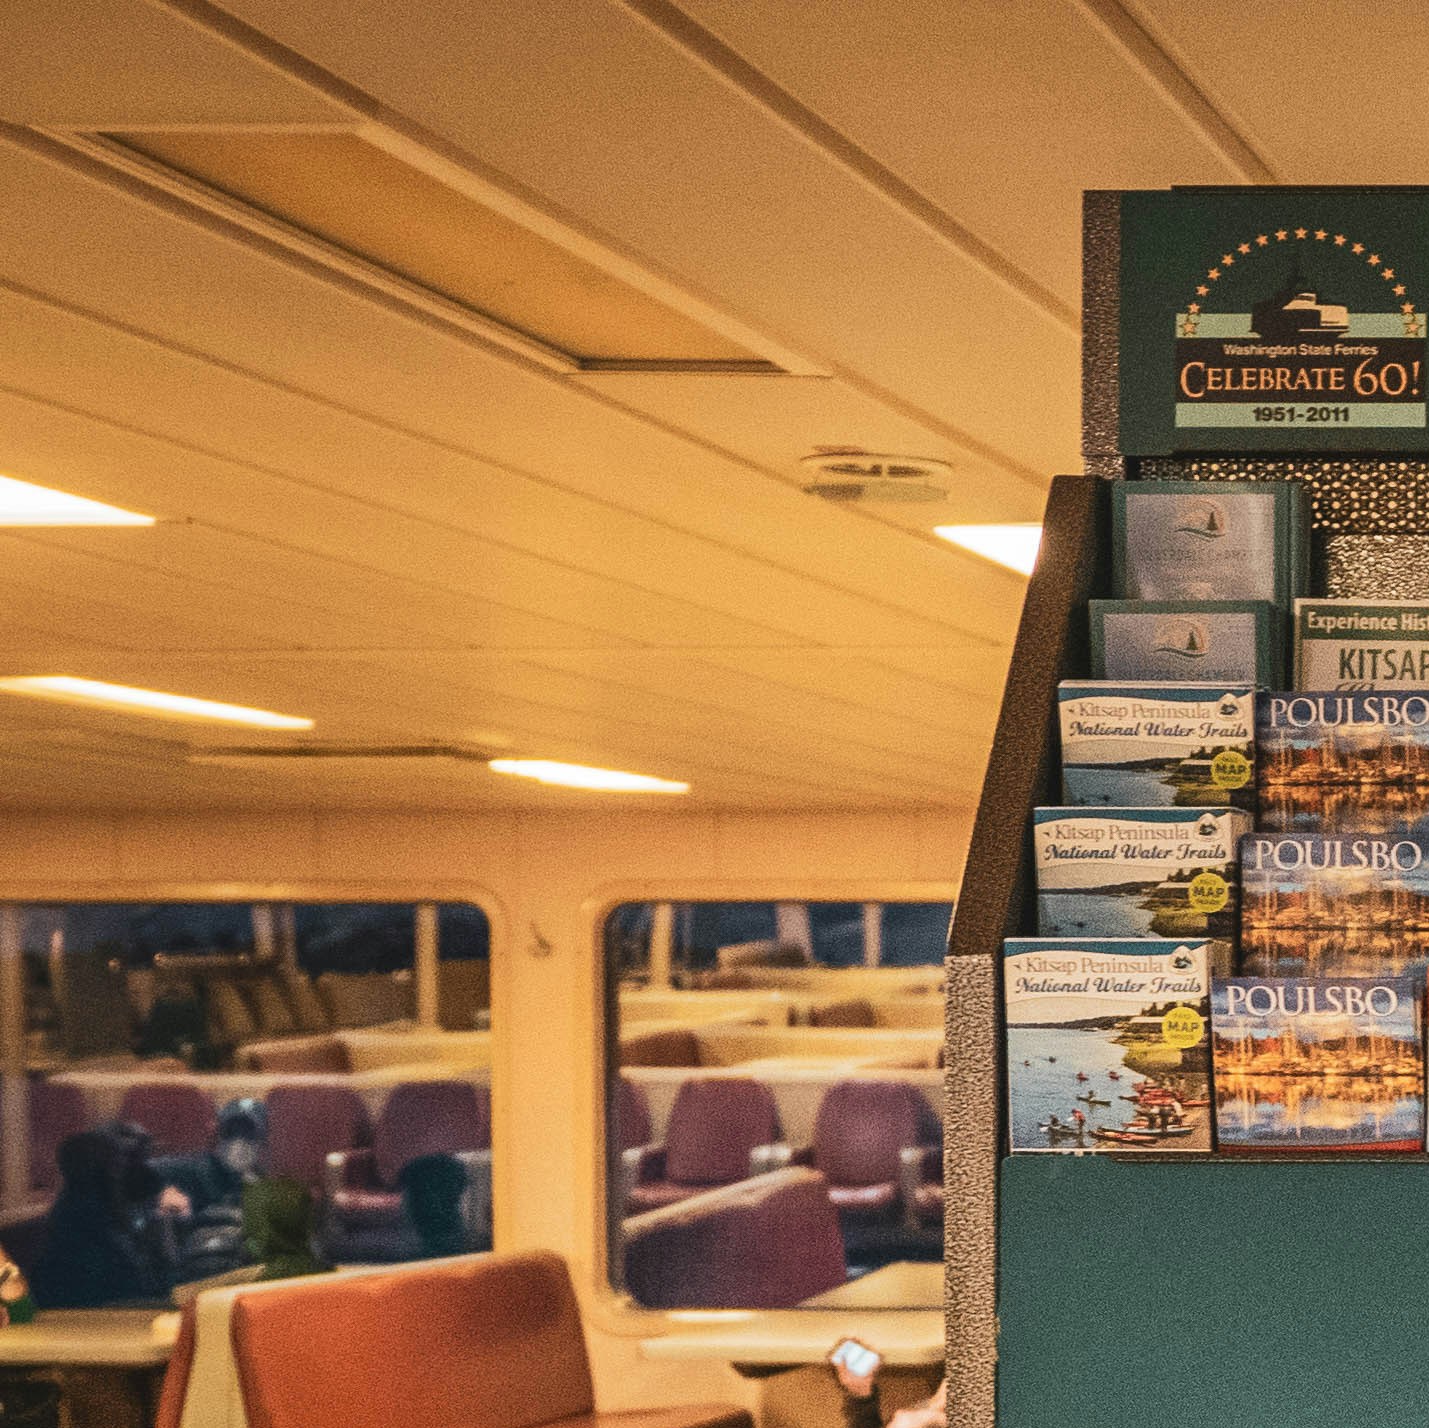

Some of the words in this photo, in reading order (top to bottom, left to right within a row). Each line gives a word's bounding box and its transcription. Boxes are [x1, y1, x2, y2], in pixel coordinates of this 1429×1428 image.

[1223, 344, 1297, 358] Washington
[1300, 344, 1331, 355] State
[1335, 344, 1378, 355] Ferries
[1353, 357, 1420, 395] 60!
[1253, 407, 1349, 422] 1951-2011
[1307, 612, 1397, 634] Experience
[1027, 957, 1078, 976] Kitsap
[1081, 957, 1164, 974] Peninsula
[1016, 977, 1091, 993] National
[1097, 977, 1146, 993] Water
[1151, 977, 1201, 993] Trails
[1225, 986, 1398, 1017] POULSBO
[1167, 1021, 1199, 1032] MAP
